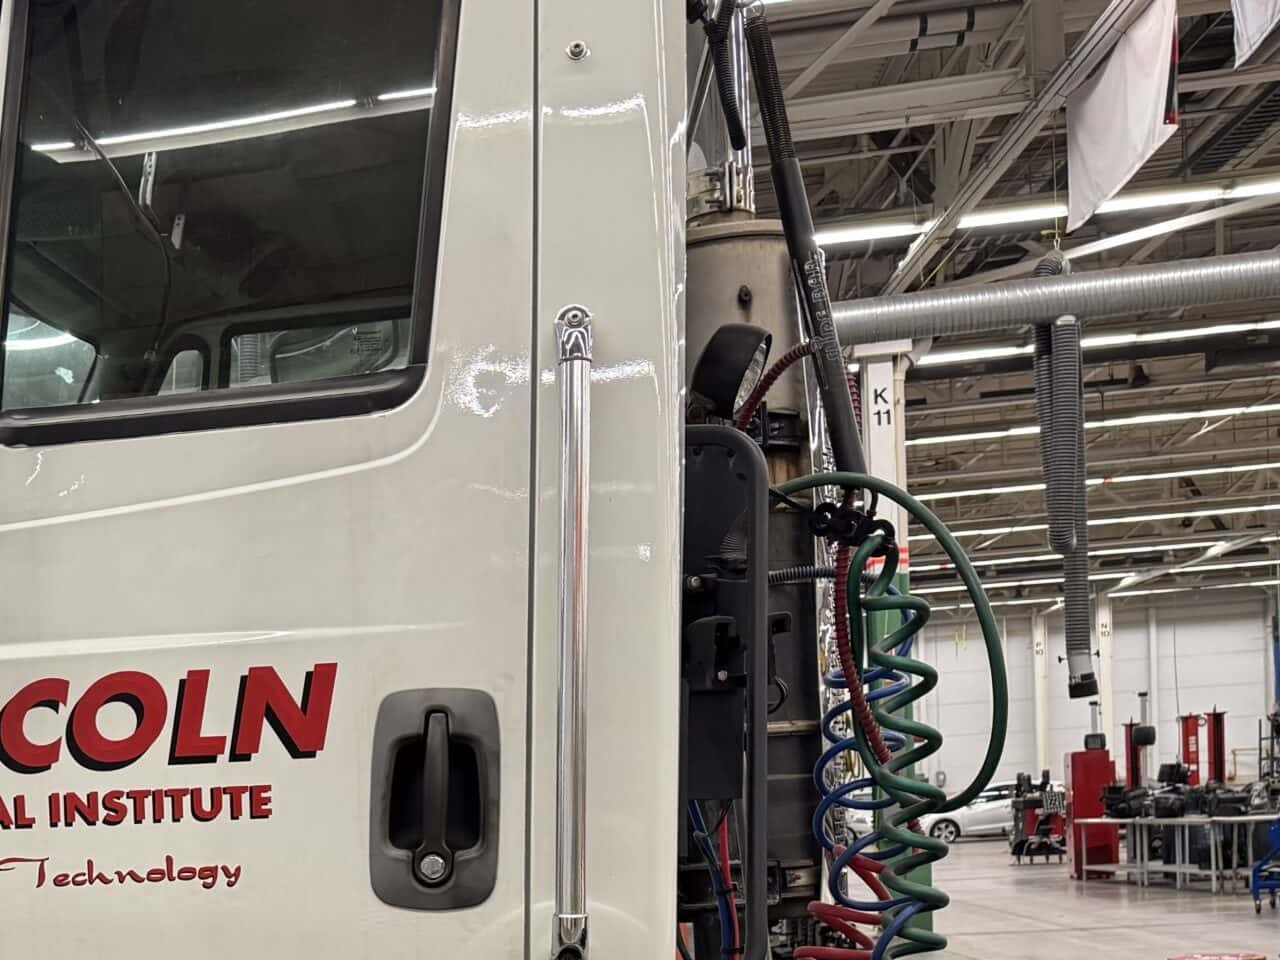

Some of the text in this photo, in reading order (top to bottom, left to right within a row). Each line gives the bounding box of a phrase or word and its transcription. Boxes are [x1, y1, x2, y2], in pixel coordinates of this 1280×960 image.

[874, 387, 889, 405] K
[872, 409, 891, 426] 11
[48, 784, 273, 828] INSTITUTE
